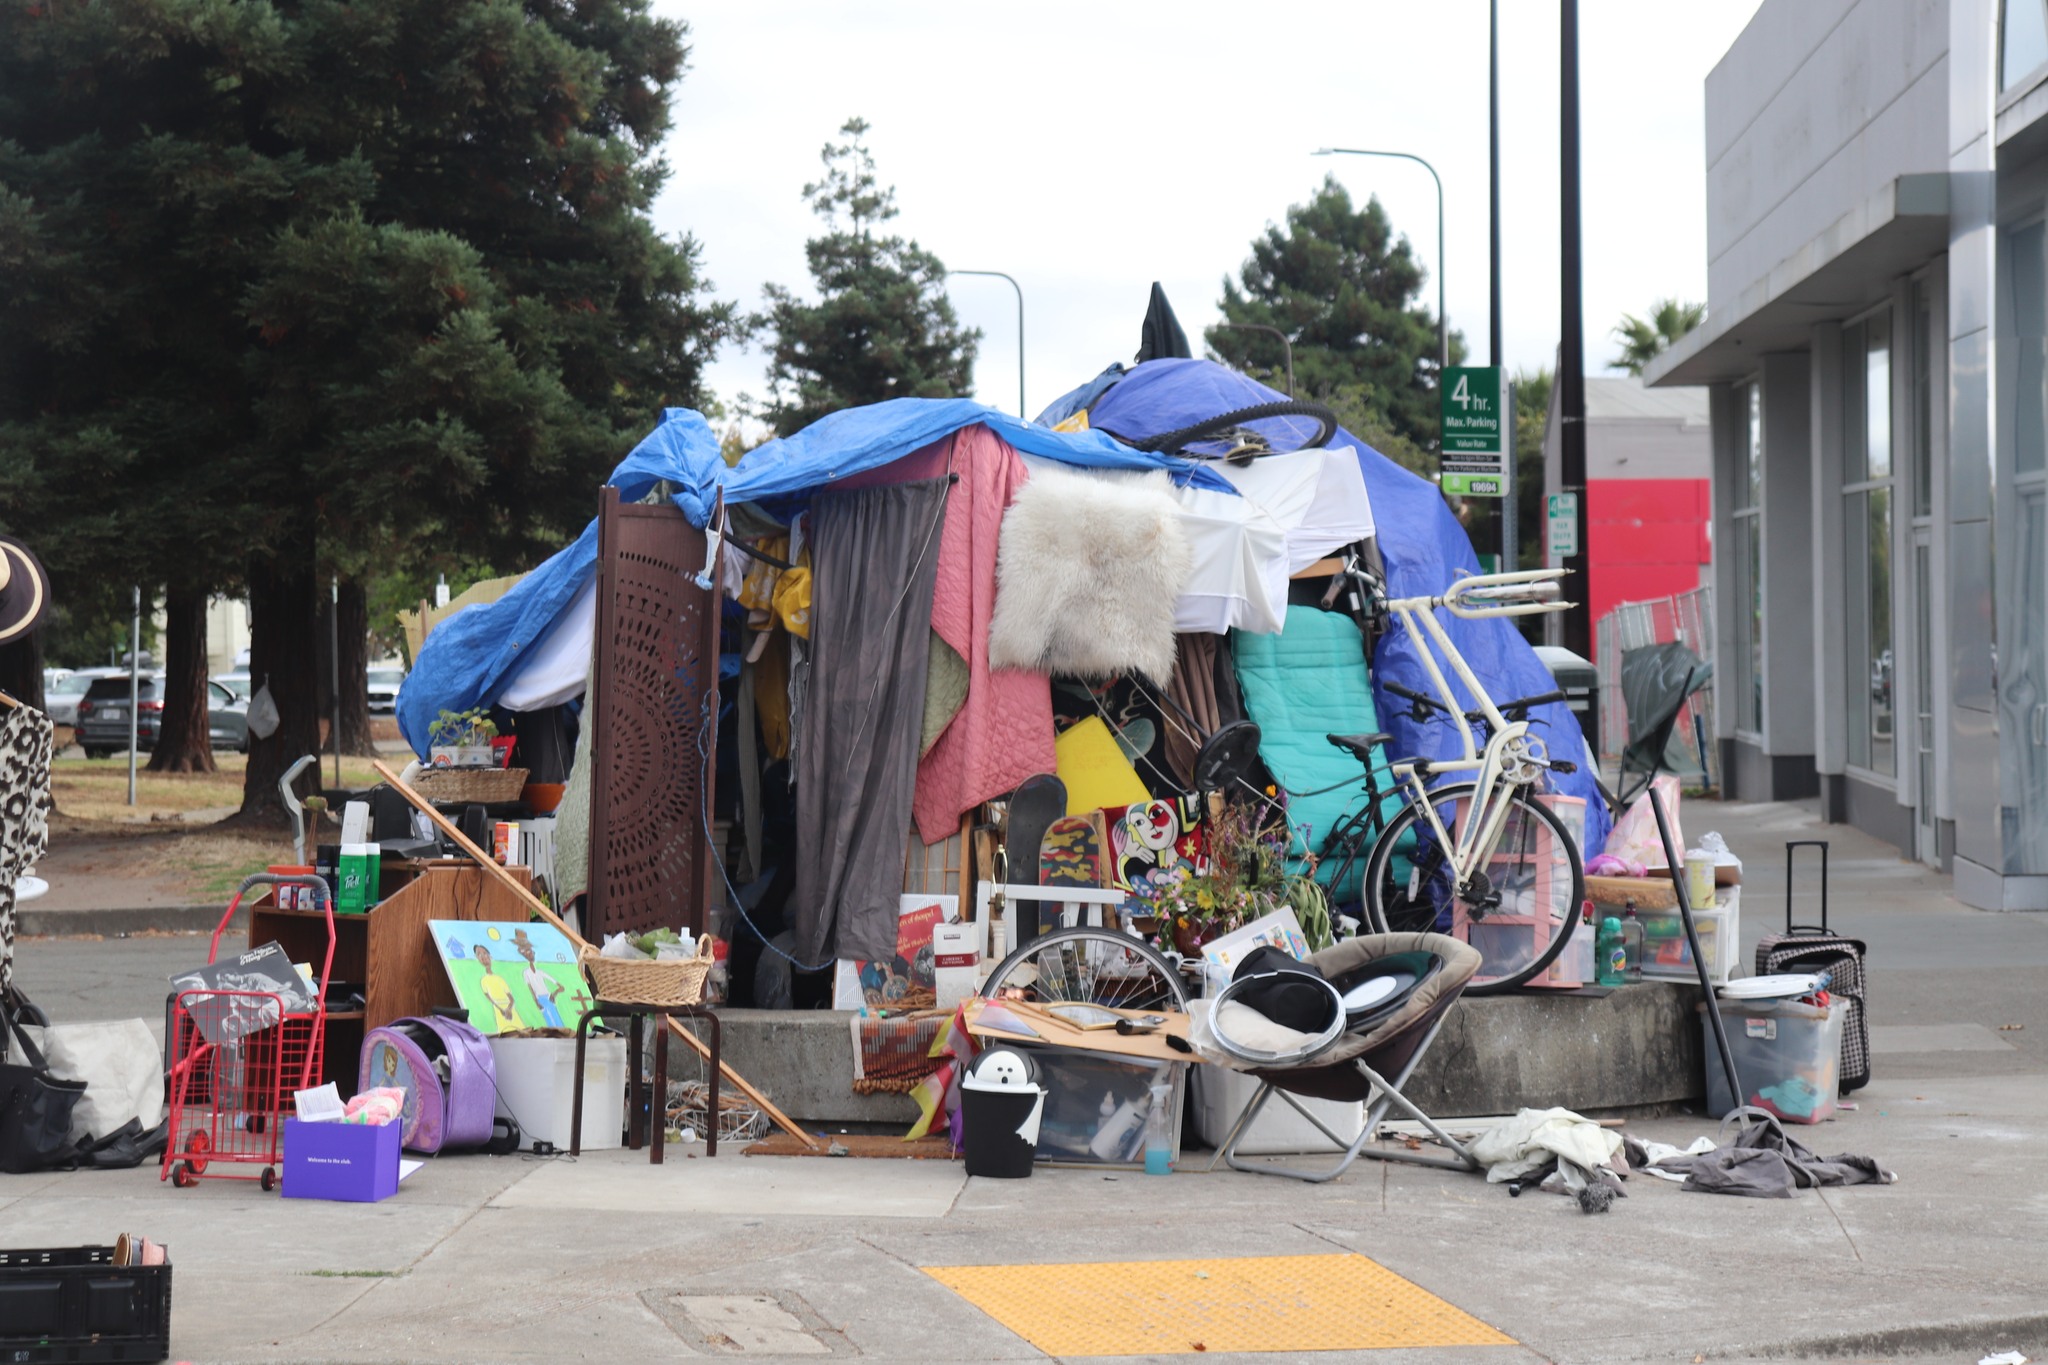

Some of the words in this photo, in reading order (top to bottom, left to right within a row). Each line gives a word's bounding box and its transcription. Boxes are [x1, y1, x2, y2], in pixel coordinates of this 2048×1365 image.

[1451, 374, 1471, 411] 4
[1473, 393, 1491, 411] hr.
[1446, 416, 1466, 428] Max.
[1467, 416, 1498, 431] Parking
[1456, 439, 1473, 448] Value
[1473, 440, 1488, 449] Rate
[1471, 481, 1497, 493] 19694
[345, 875, 361, 890] Prell
